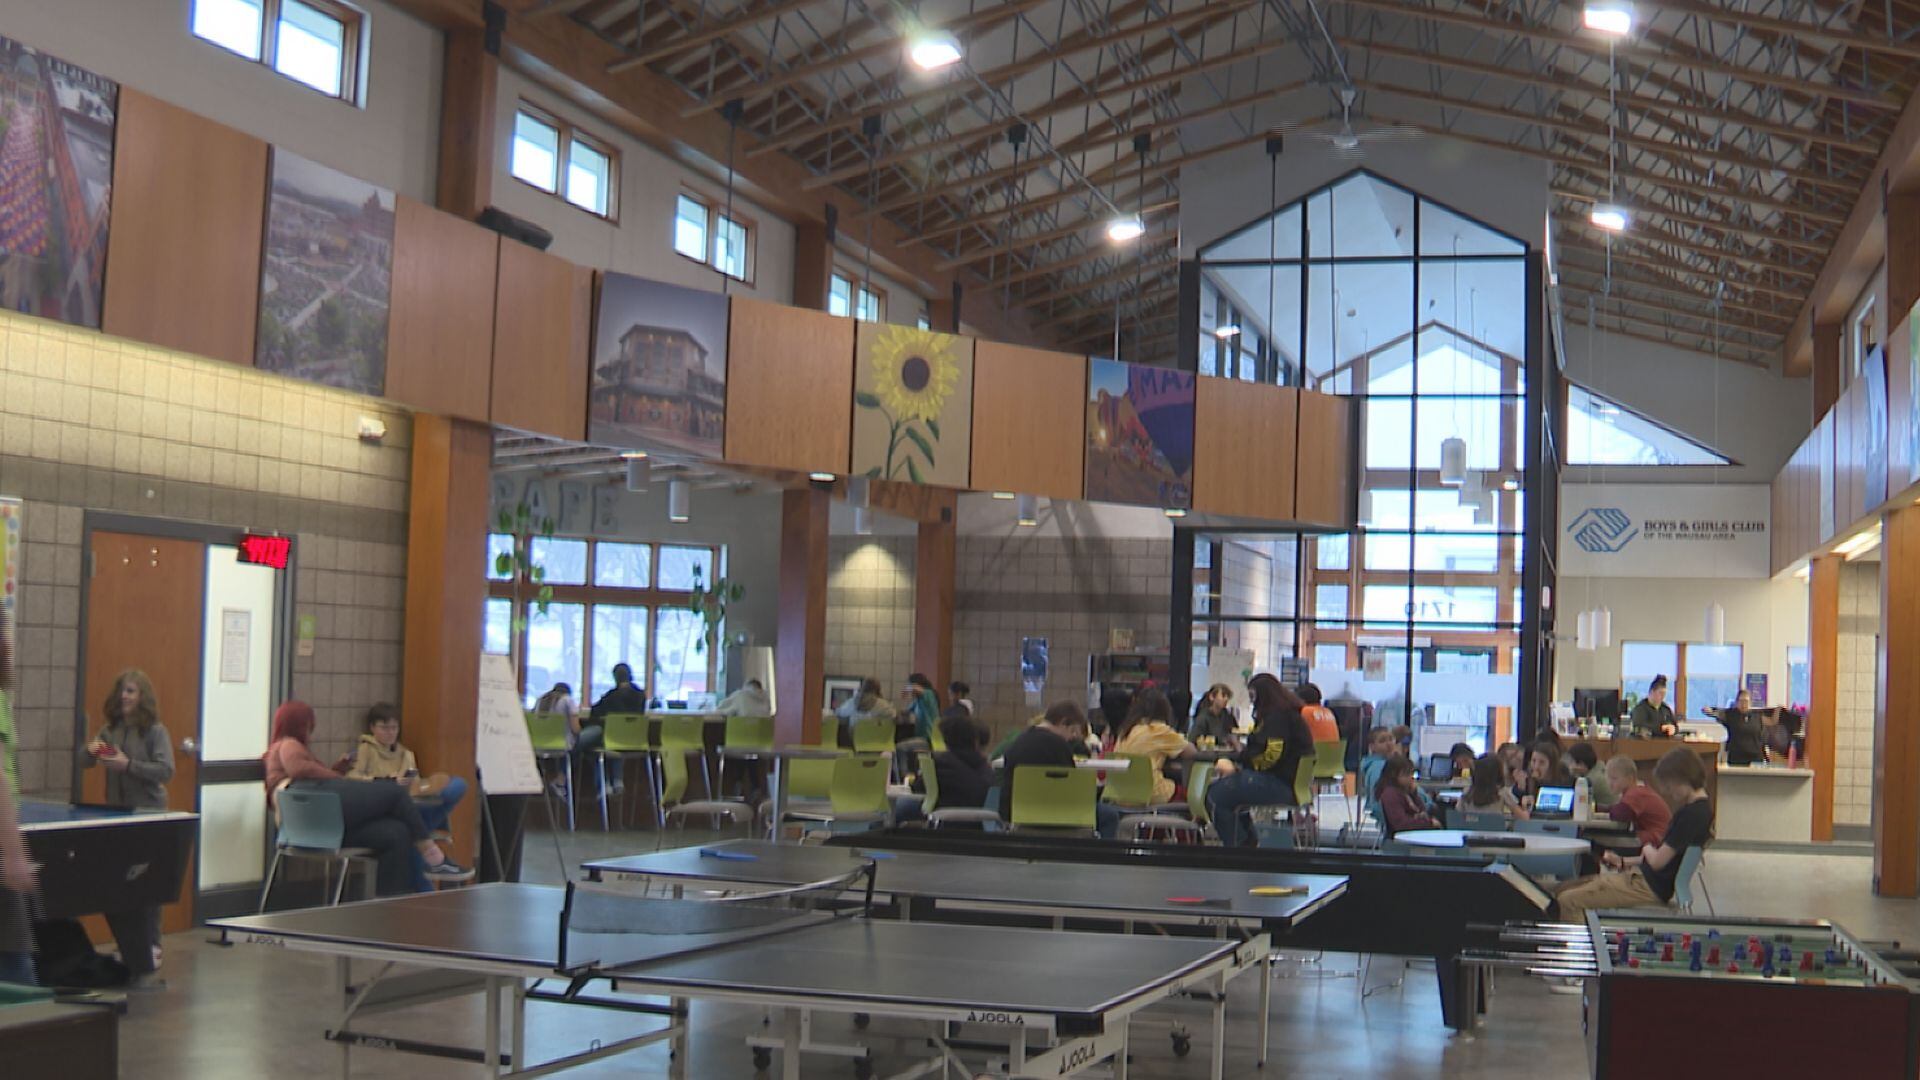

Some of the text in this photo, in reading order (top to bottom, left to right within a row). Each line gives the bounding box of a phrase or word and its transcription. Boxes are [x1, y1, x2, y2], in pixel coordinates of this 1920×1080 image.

[1643, 520, 1766, 533] BOYS & GIRLS CLUB
[1643, 532, 1736, 541] OF THE WAUSAU AREA
[979, 1012, 1024, 1024] JOOLA
[1066, 1042, 1096, 1071] JOOLA
